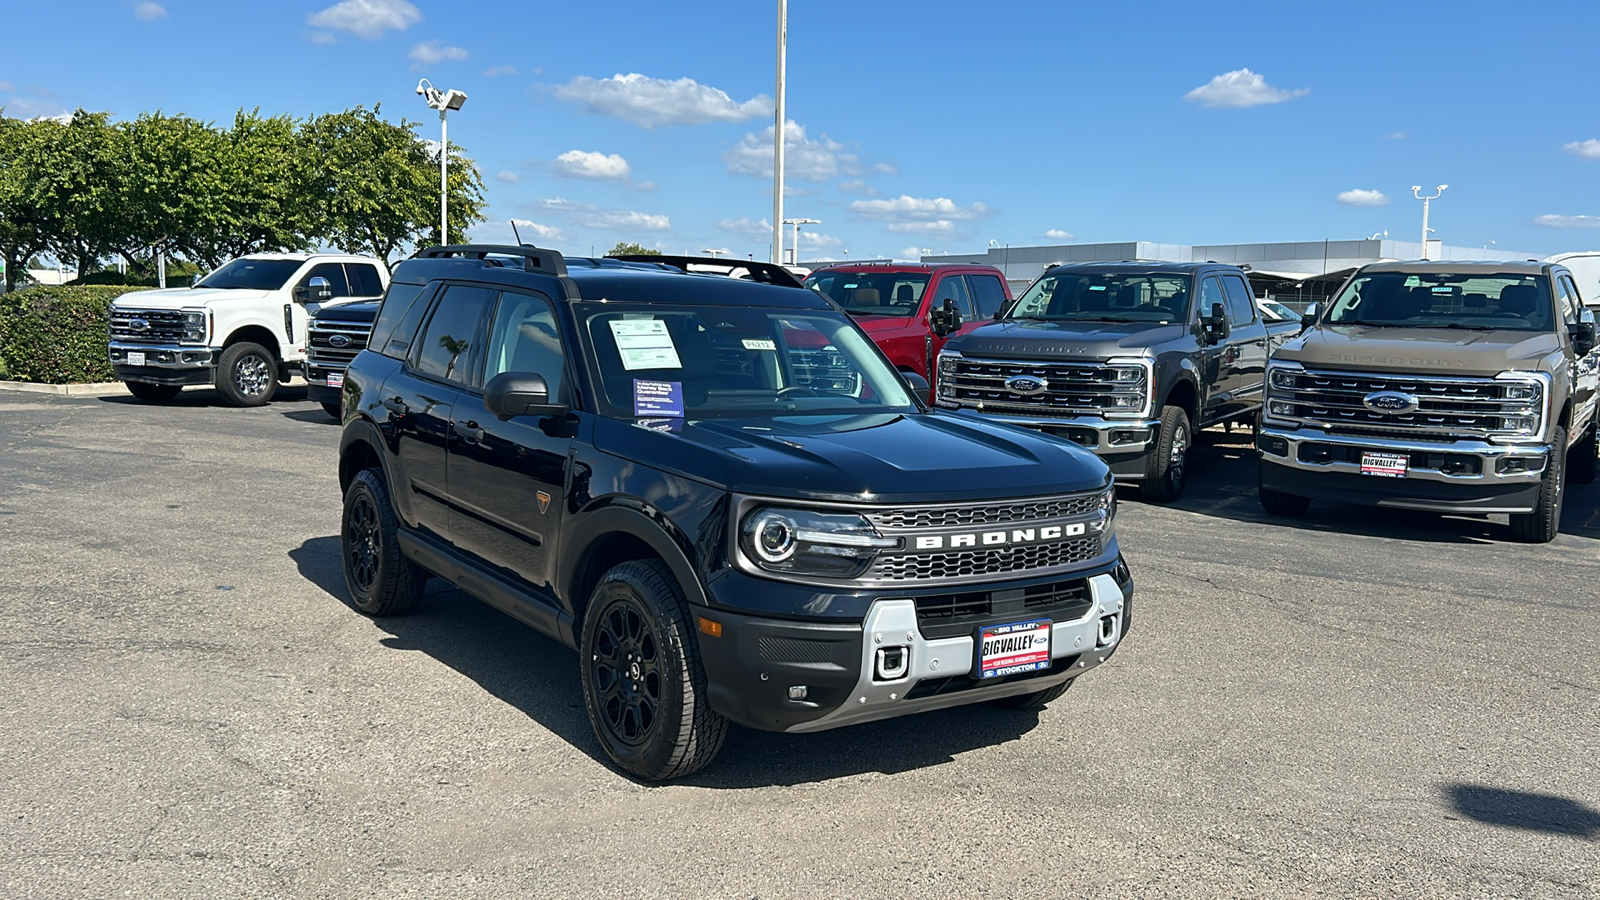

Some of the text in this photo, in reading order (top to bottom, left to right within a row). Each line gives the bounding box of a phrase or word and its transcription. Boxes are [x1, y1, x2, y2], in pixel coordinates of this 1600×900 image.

[746, 341, 771, 349] P6212
[1326, 353, 1471, 368] SUPER DUTY
[1363, 458, 1397, 468] BIGVALLEY
[916, 522, 1086, 549] BRONCO
[1011, 622, 1036, 631] VALLEY
[983, 634, 1035, 656] BIGVALLEY
[996, 663, 1036, 675] STOCKTON
